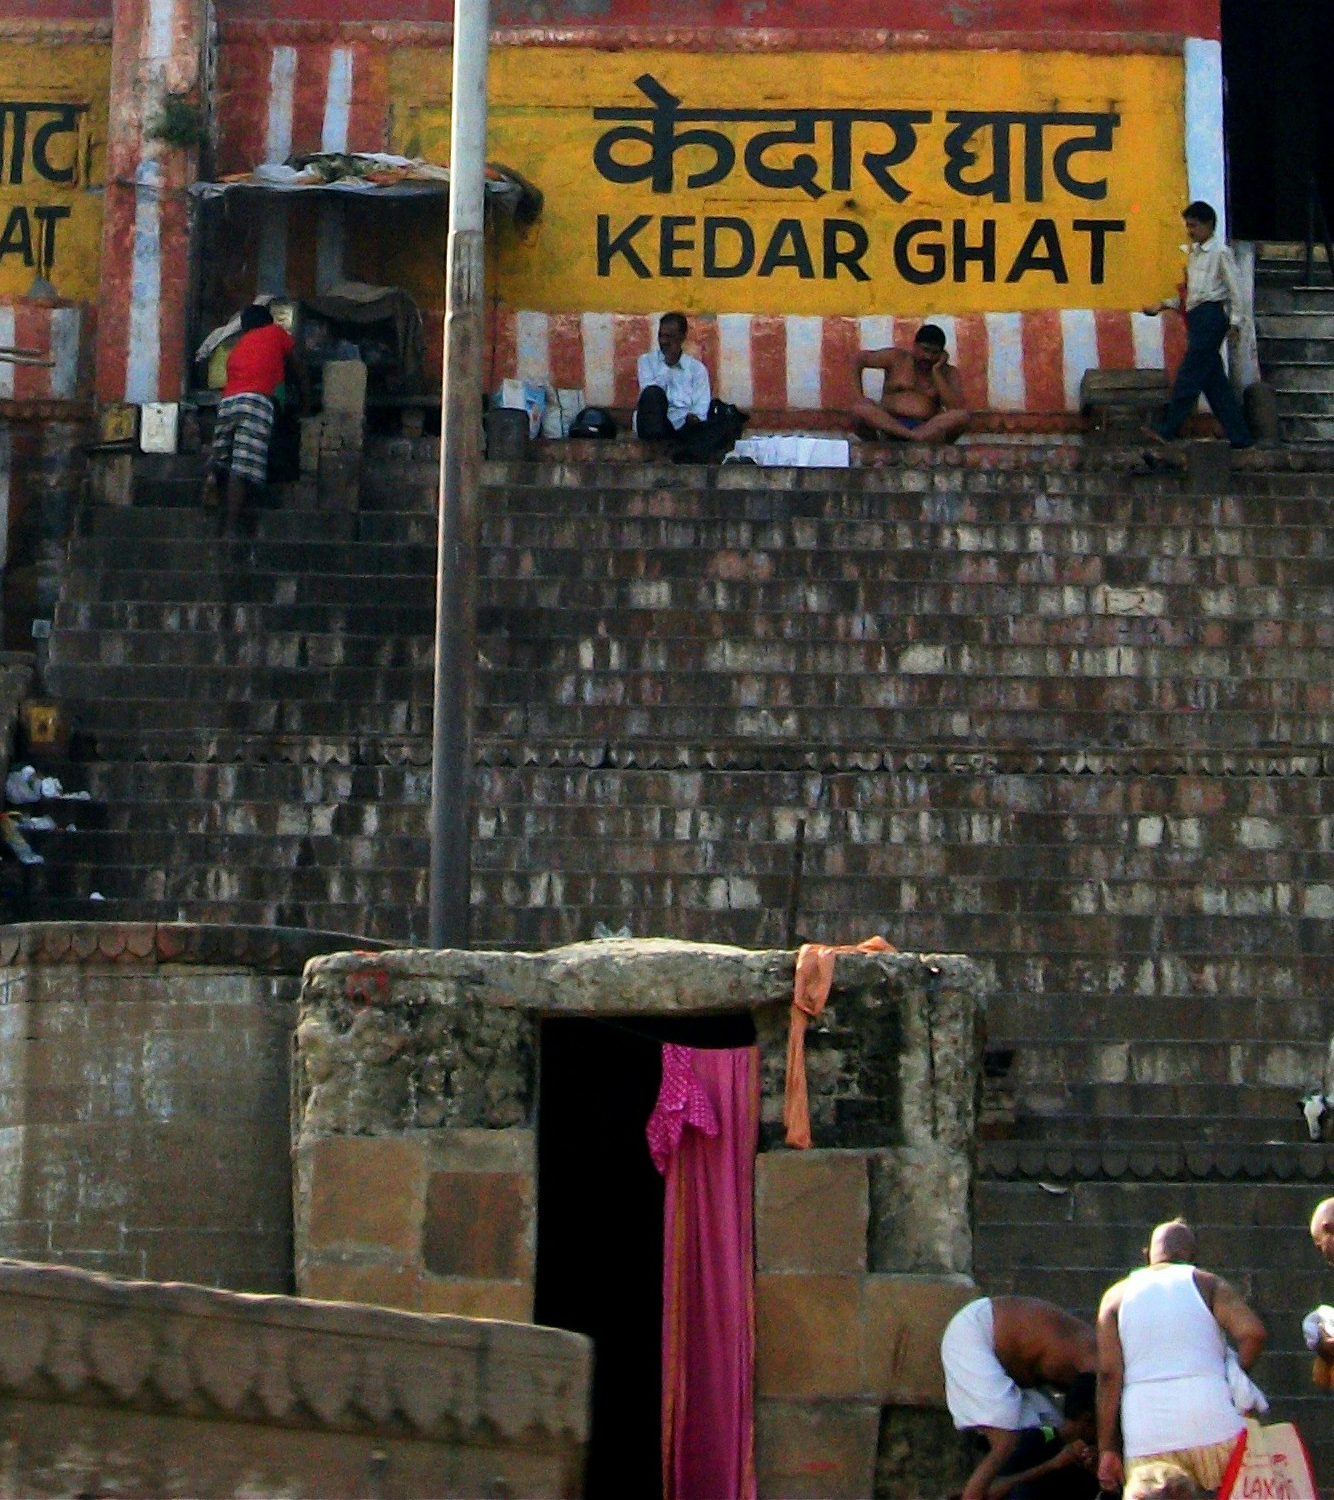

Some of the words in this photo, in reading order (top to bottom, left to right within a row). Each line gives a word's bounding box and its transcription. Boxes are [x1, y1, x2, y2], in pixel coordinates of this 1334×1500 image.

[593, 73, 932, 202] केदार
[944, 110, 1121, 203] घाट
[596, 213, 871, 283] KEDAR
[893, 218, 1125, 285] GHAT
